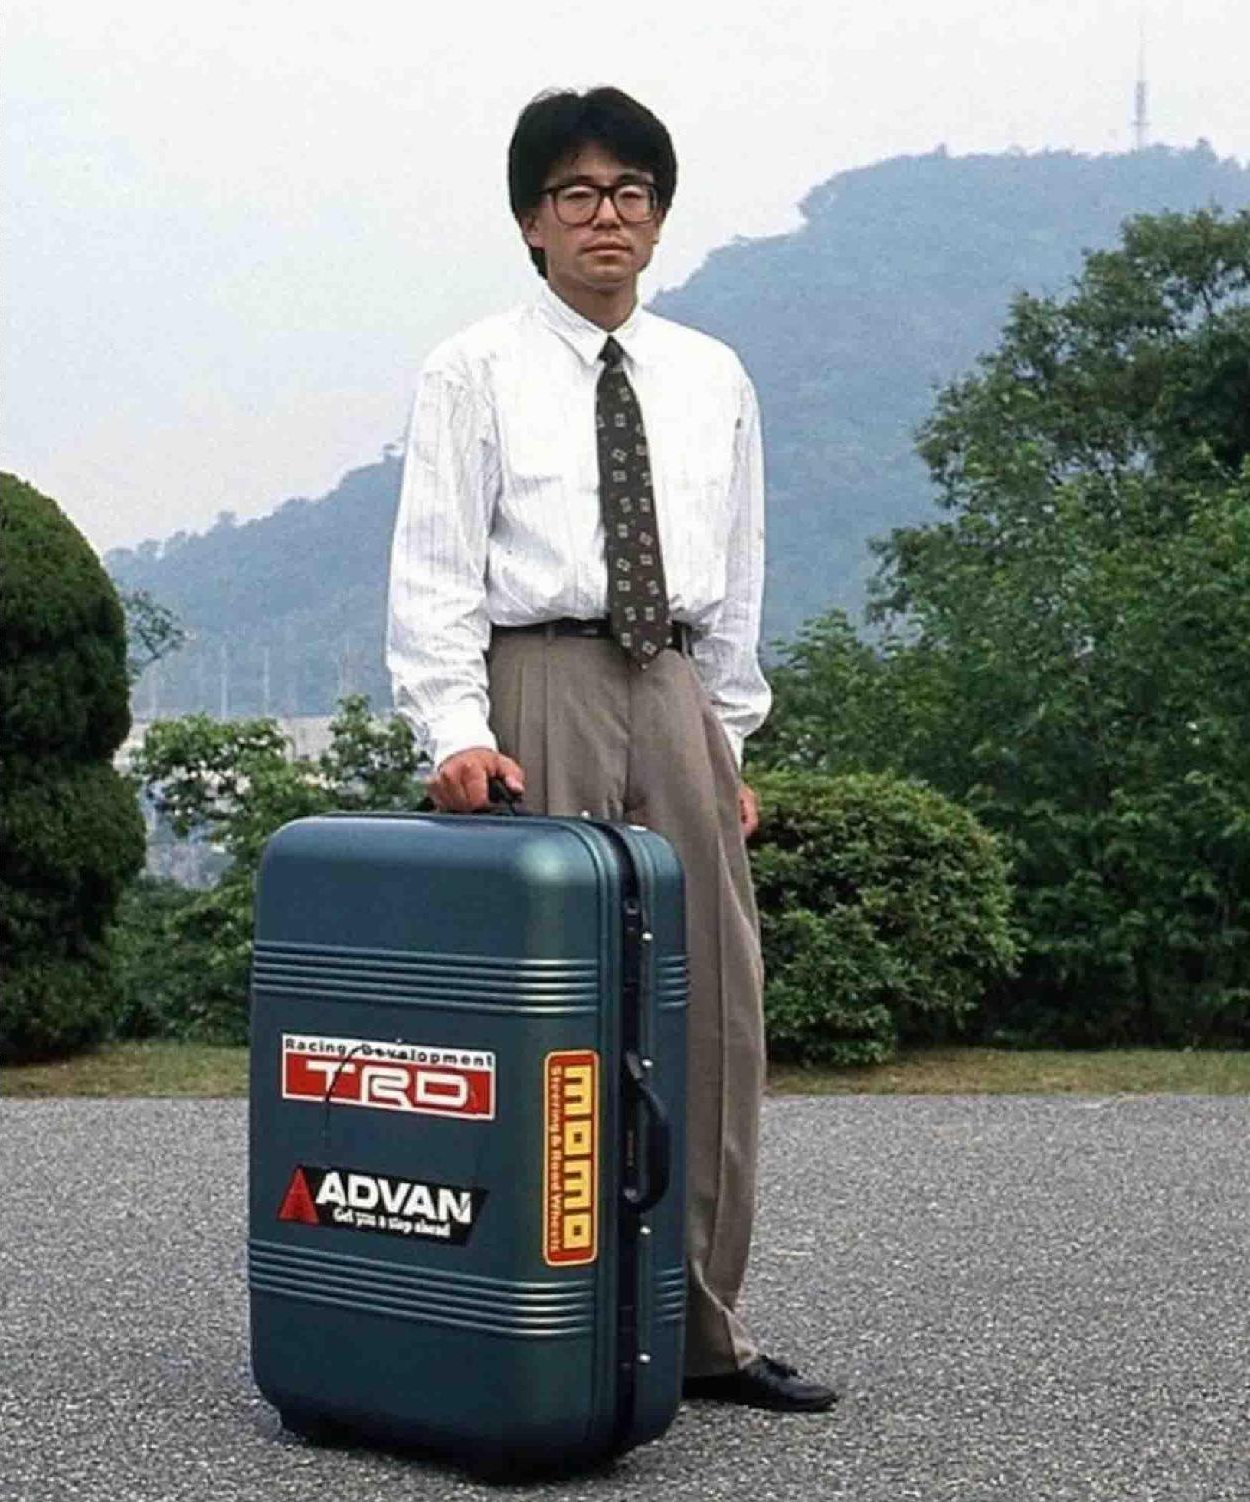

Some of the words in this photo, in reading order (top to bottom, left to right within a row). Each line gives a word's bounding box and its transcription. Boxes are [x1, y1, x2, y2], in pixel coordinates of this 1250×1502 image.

[285, 1038, 347, 1057] Racing
[361, 1044, 493, 1067] Development
[306, 1060, 468, 1108] TRD
[563, 1065, 592, 1250] momo
[316, 1171, 471, 1224] ADVAN
